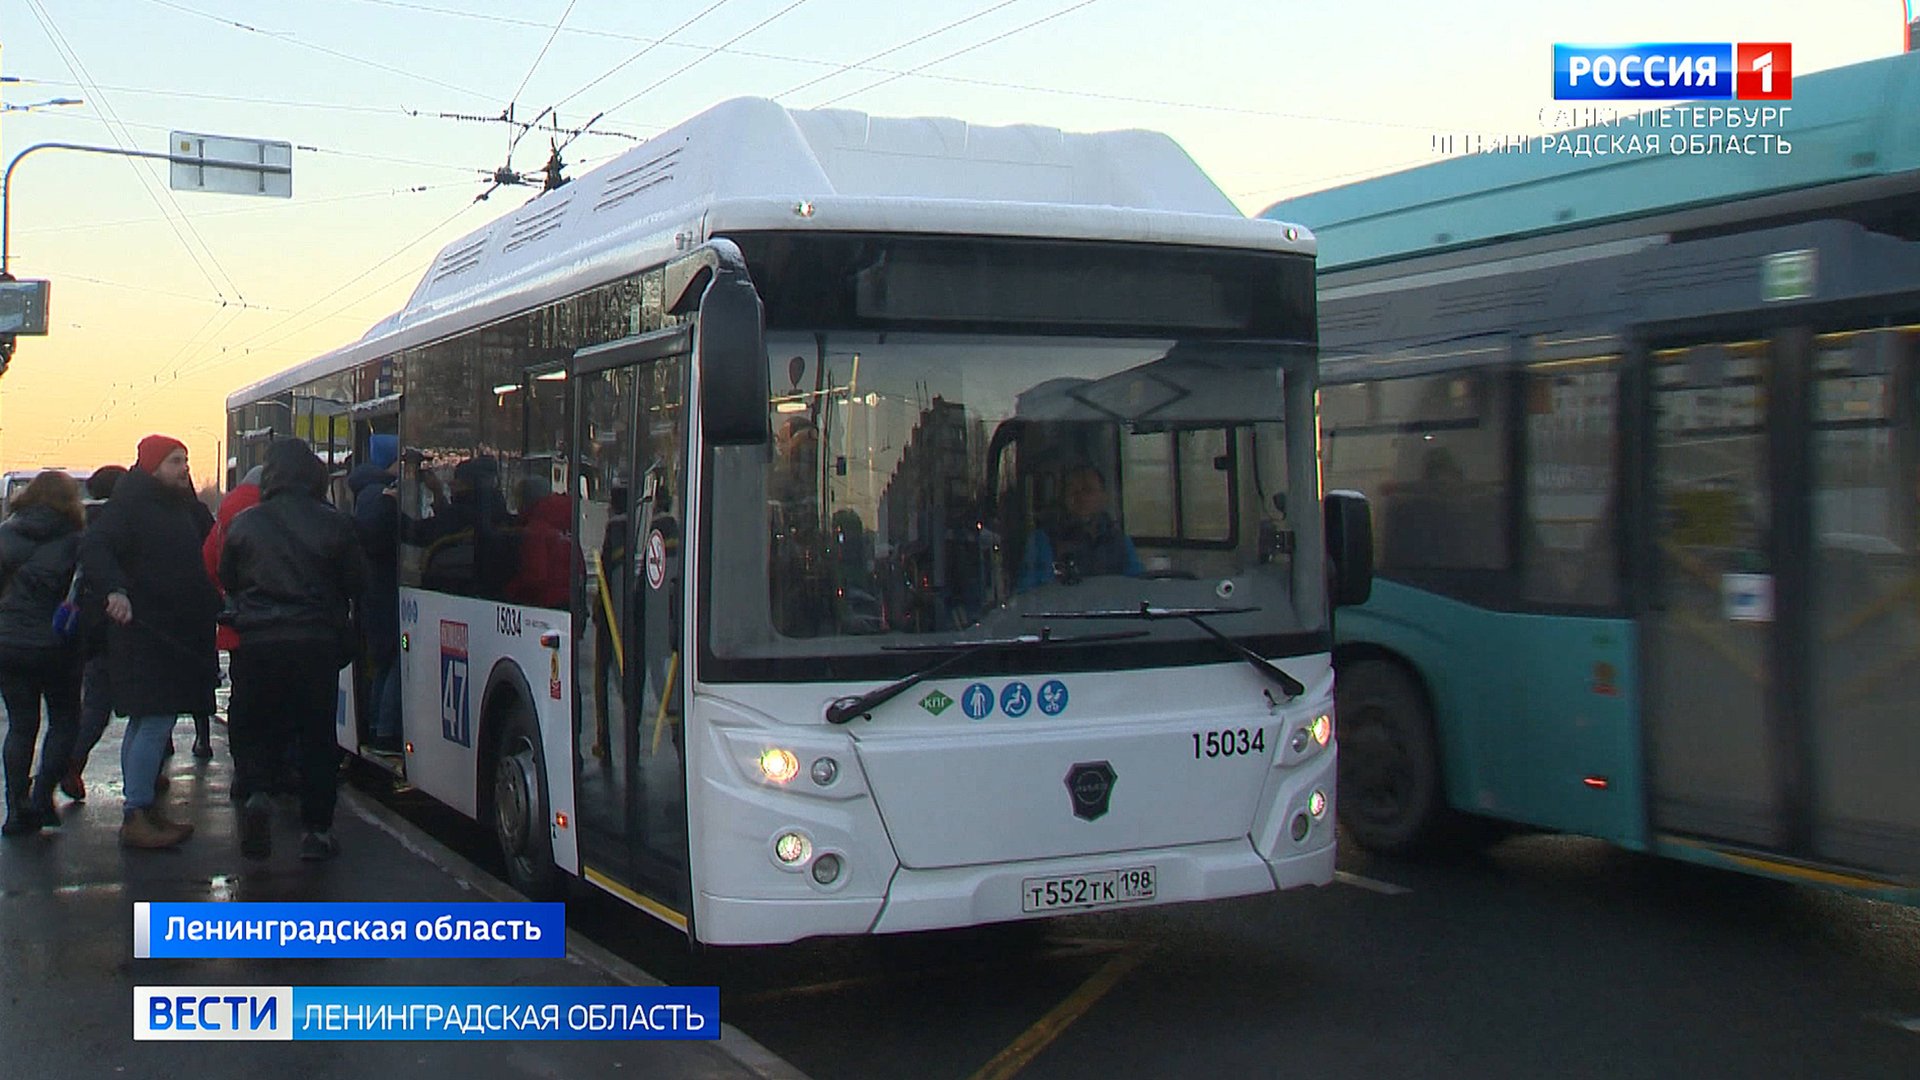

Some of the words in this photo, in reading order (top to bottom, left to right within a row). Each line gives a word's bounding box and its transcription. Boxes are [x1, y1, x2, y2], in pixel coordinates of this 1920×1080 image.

[496, 605, 522, 637] 15034
[443, 660, 467, 740] 47
[924, 696, 946, 709] КПГ
[1192, 728, 1265, 758] 15034
[1120, 871, 1151, 890] 198
